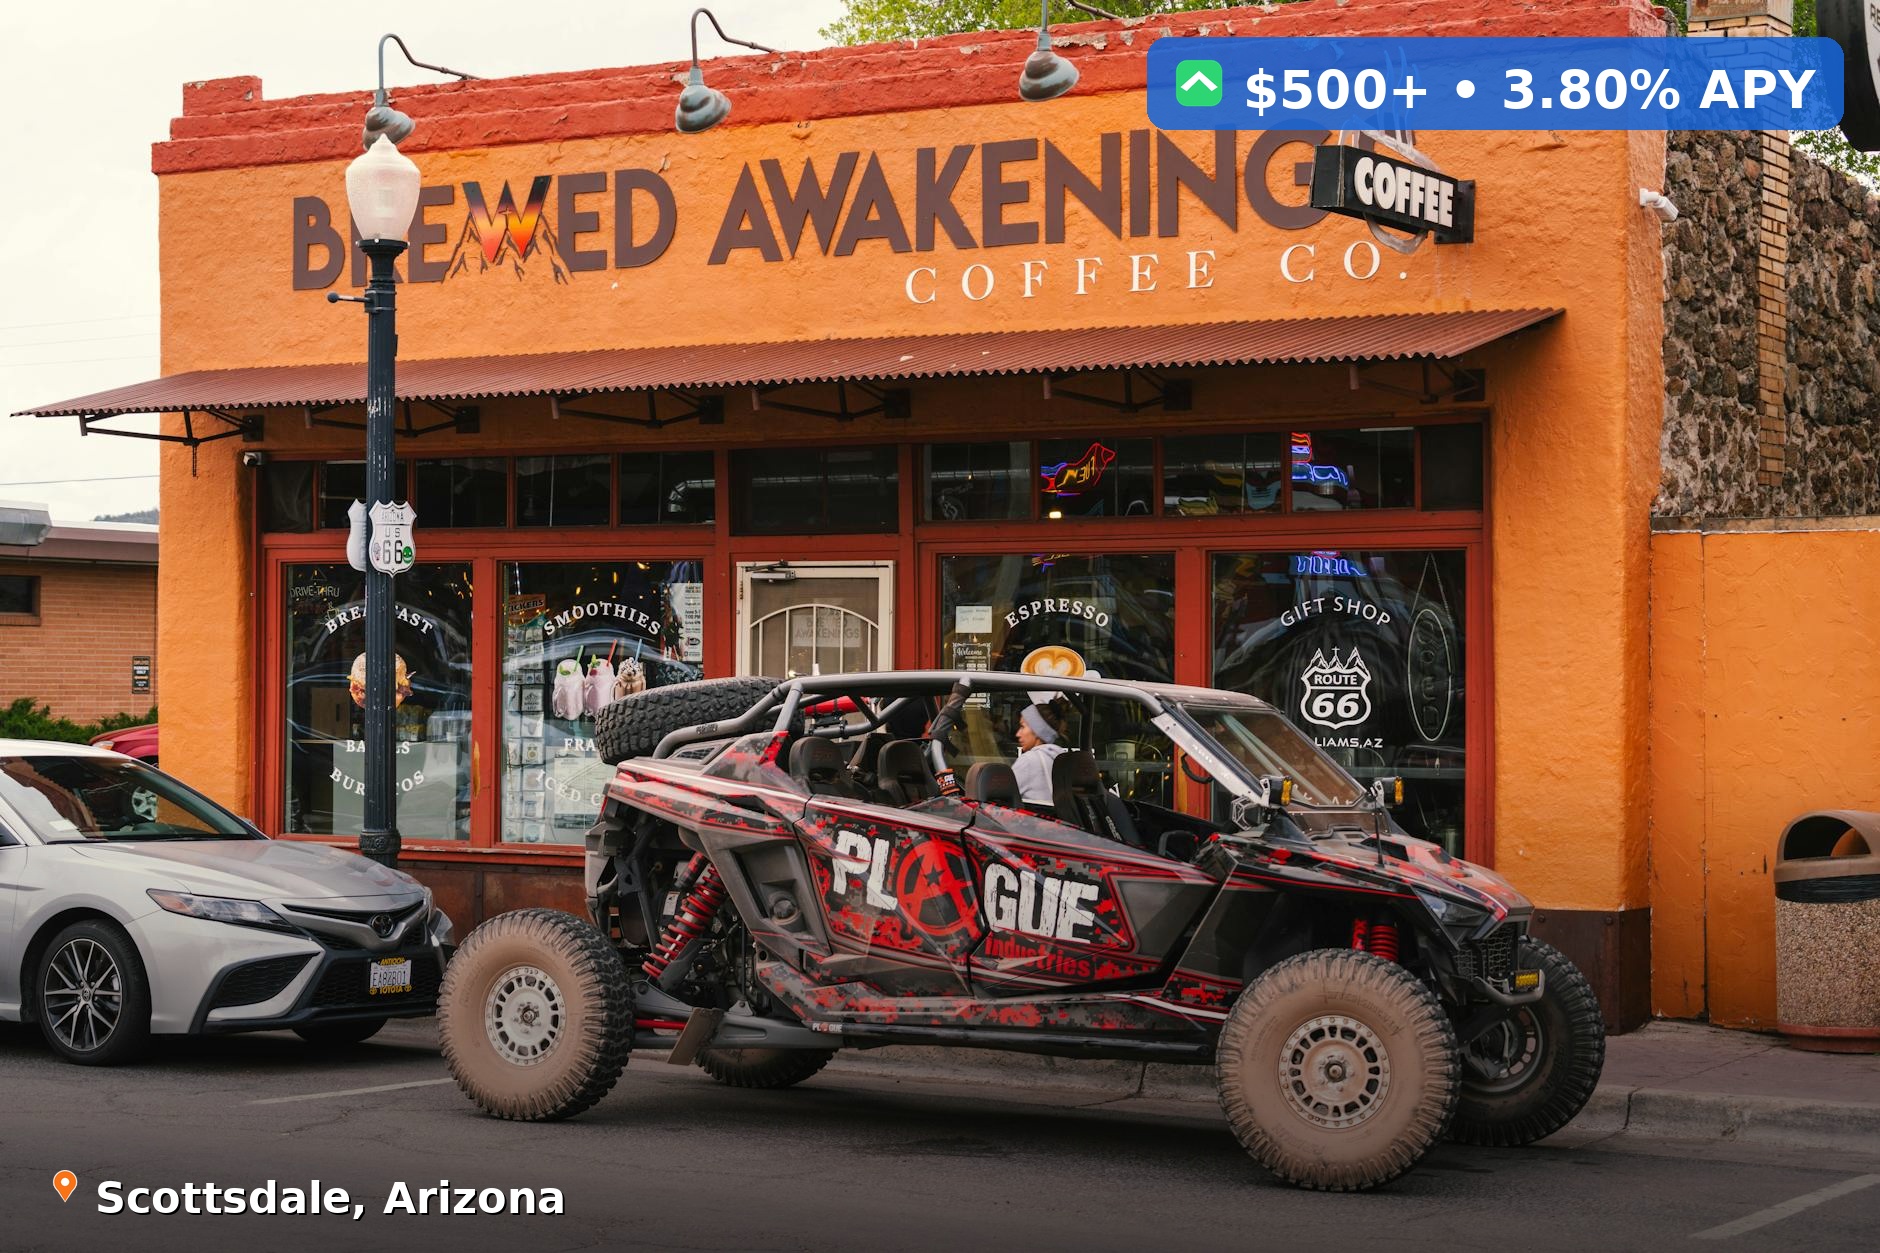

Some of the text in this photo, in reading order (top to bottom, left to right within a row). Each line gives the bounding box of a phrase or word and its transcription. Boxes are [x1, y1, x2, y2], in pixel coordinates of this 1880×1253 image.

[1354, 156, 1453, 227] COFFEE
[293, 168, 678, 291] BEWED
[905, 241, 1408, 304] COFFEE CO.
[382, 539, 403, 565] 66
[325, 604, 433, 635] BREAST
[543, 602, 662, 637] SMOOTHIES
[1004, 597, 1109, 628] ESPRESSO
[1280, 596, 1391, 627] GIFT SHOP
[1314, 674, 1358, 685] ROUTE
[1312, 692, 1360, 719] 66
[346, 739, 410, 754] BAS
[563, 737, 597, 752] FRA
[329, 766, 425, 796] BUROS
[832, 828, 1100, 944] PLAGUE
[379, 985, 403, 994] TOYOTA
